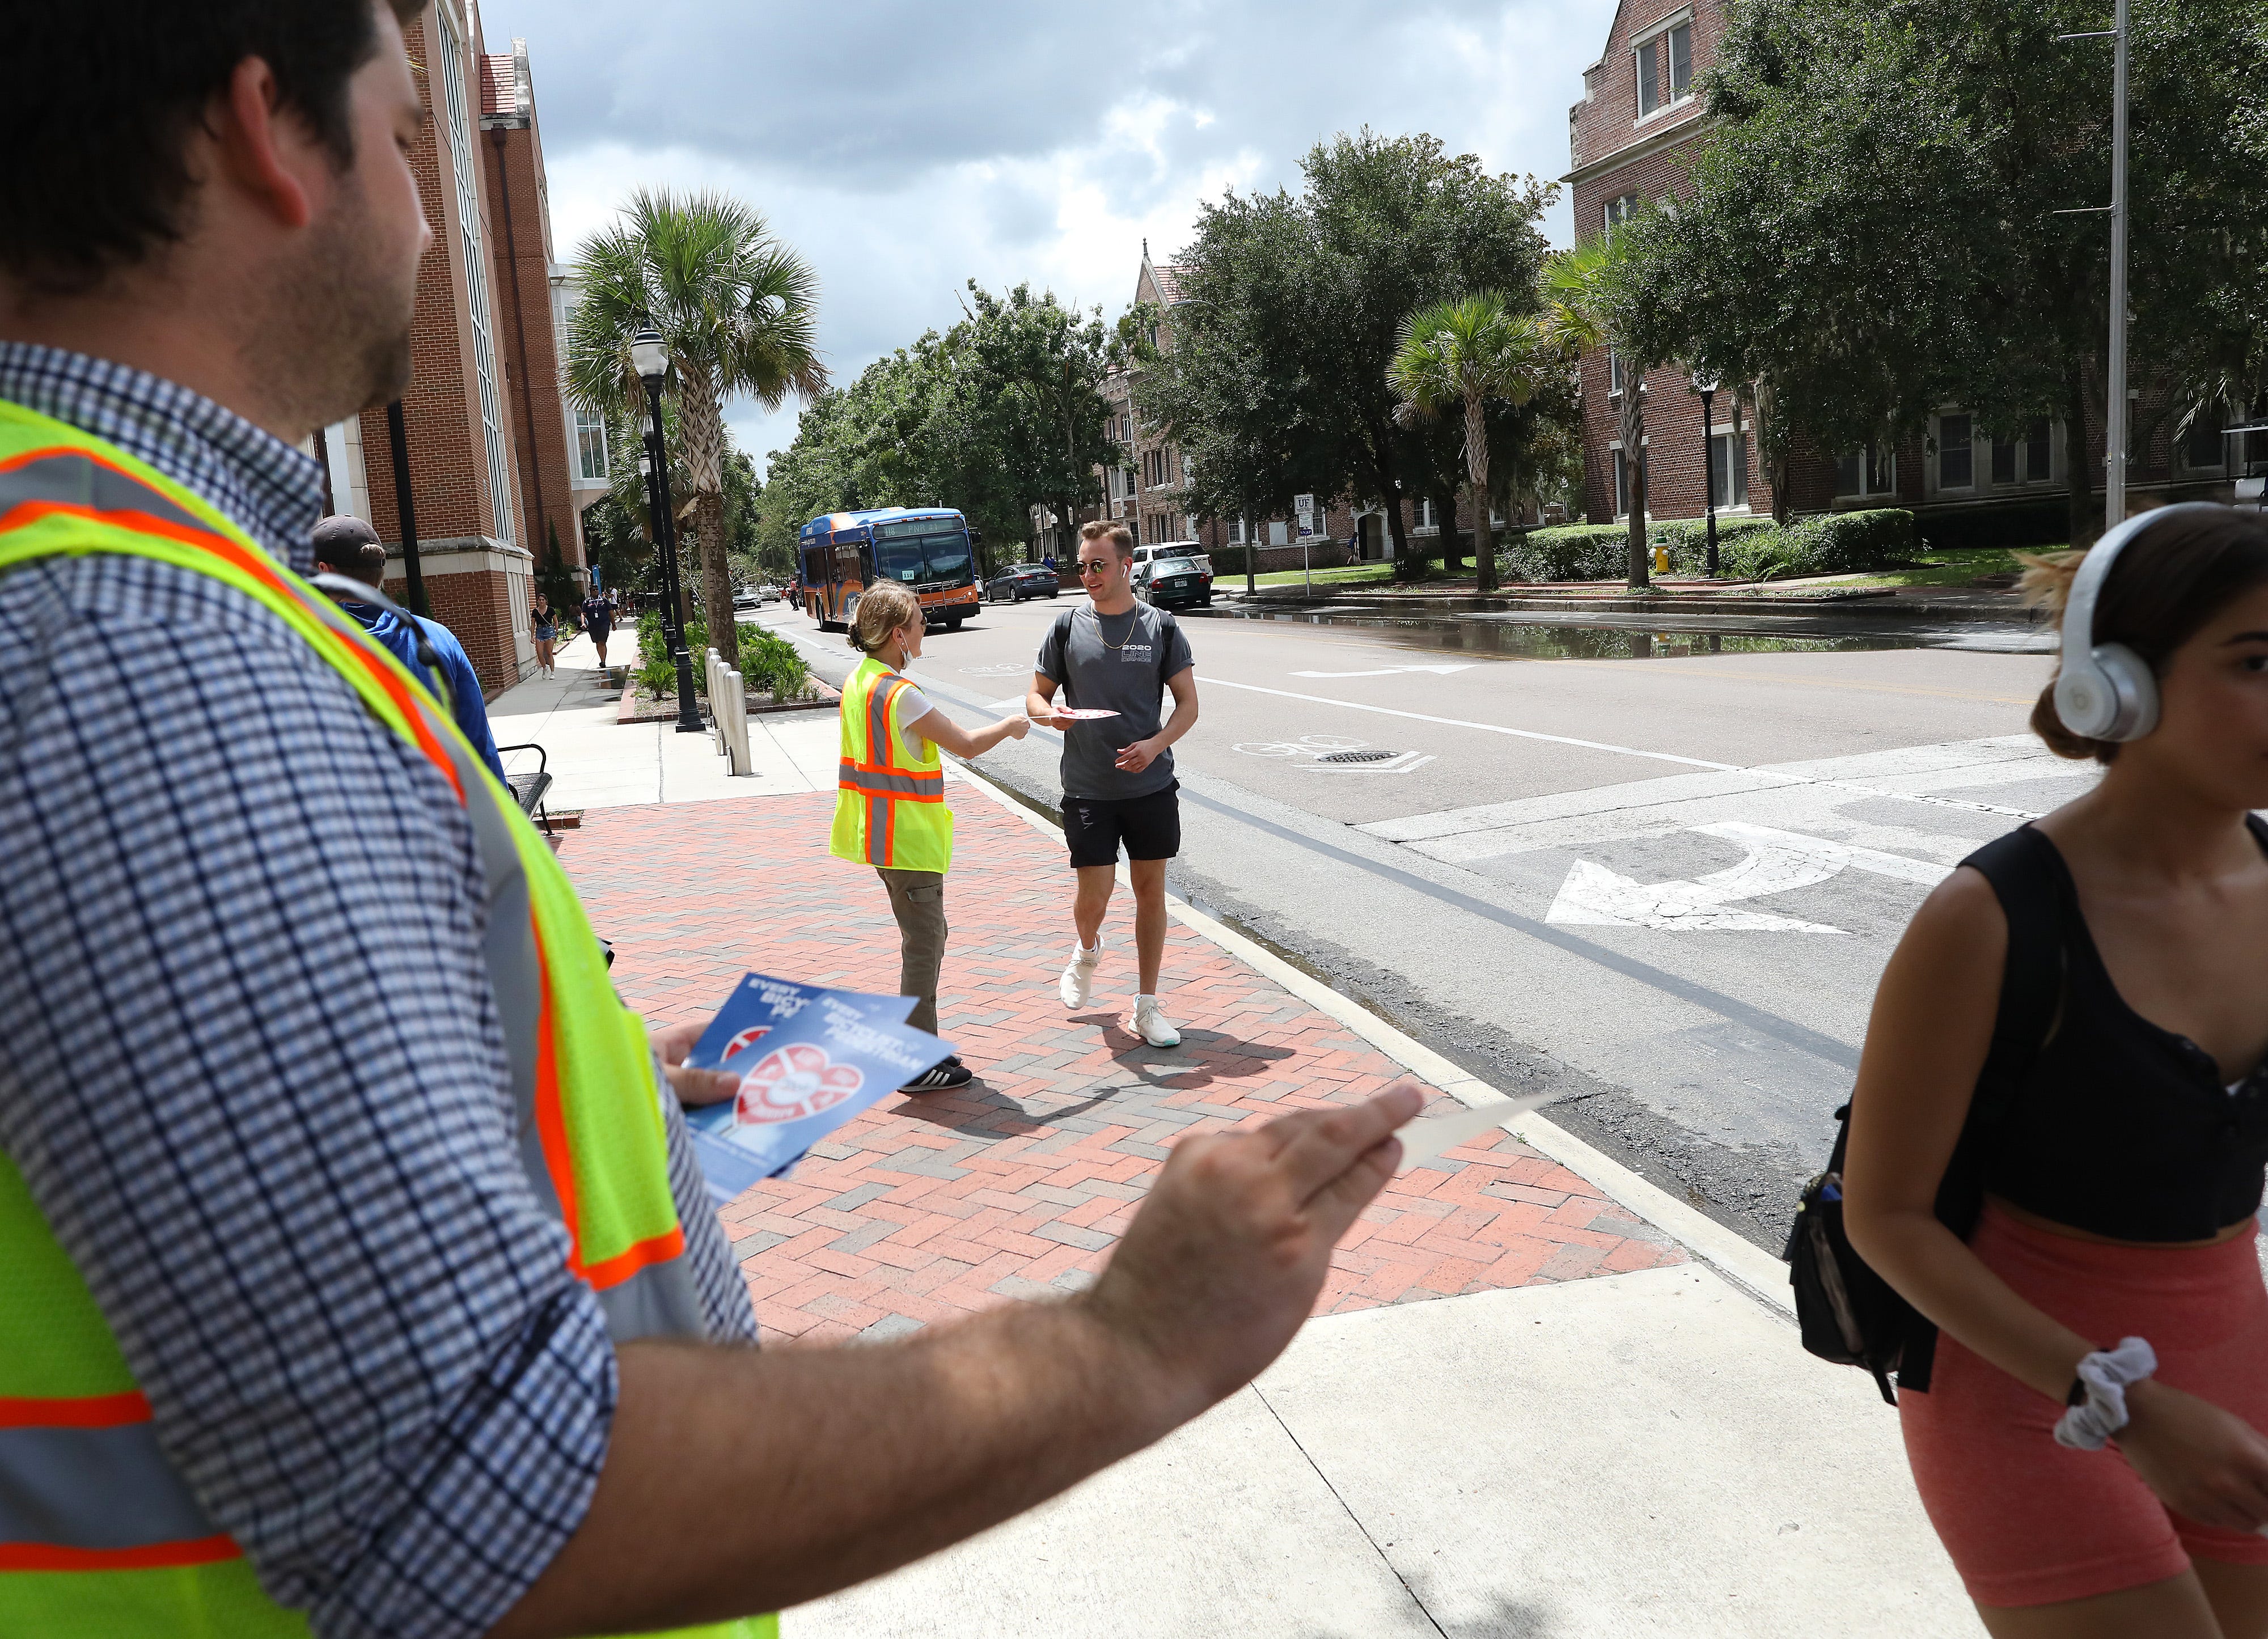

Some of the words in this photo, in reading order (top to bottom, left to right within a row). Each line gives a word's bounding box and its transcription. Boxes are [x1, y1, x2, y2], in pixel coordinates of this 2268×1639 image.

[885, 527, 895, 536] 118
[908, 524, 925, 533] PNR
[748, 977, 802, 995] EVERY
[759, 991, 811, 1010] BICY
[822, 997, 865, 1020] EVERY
